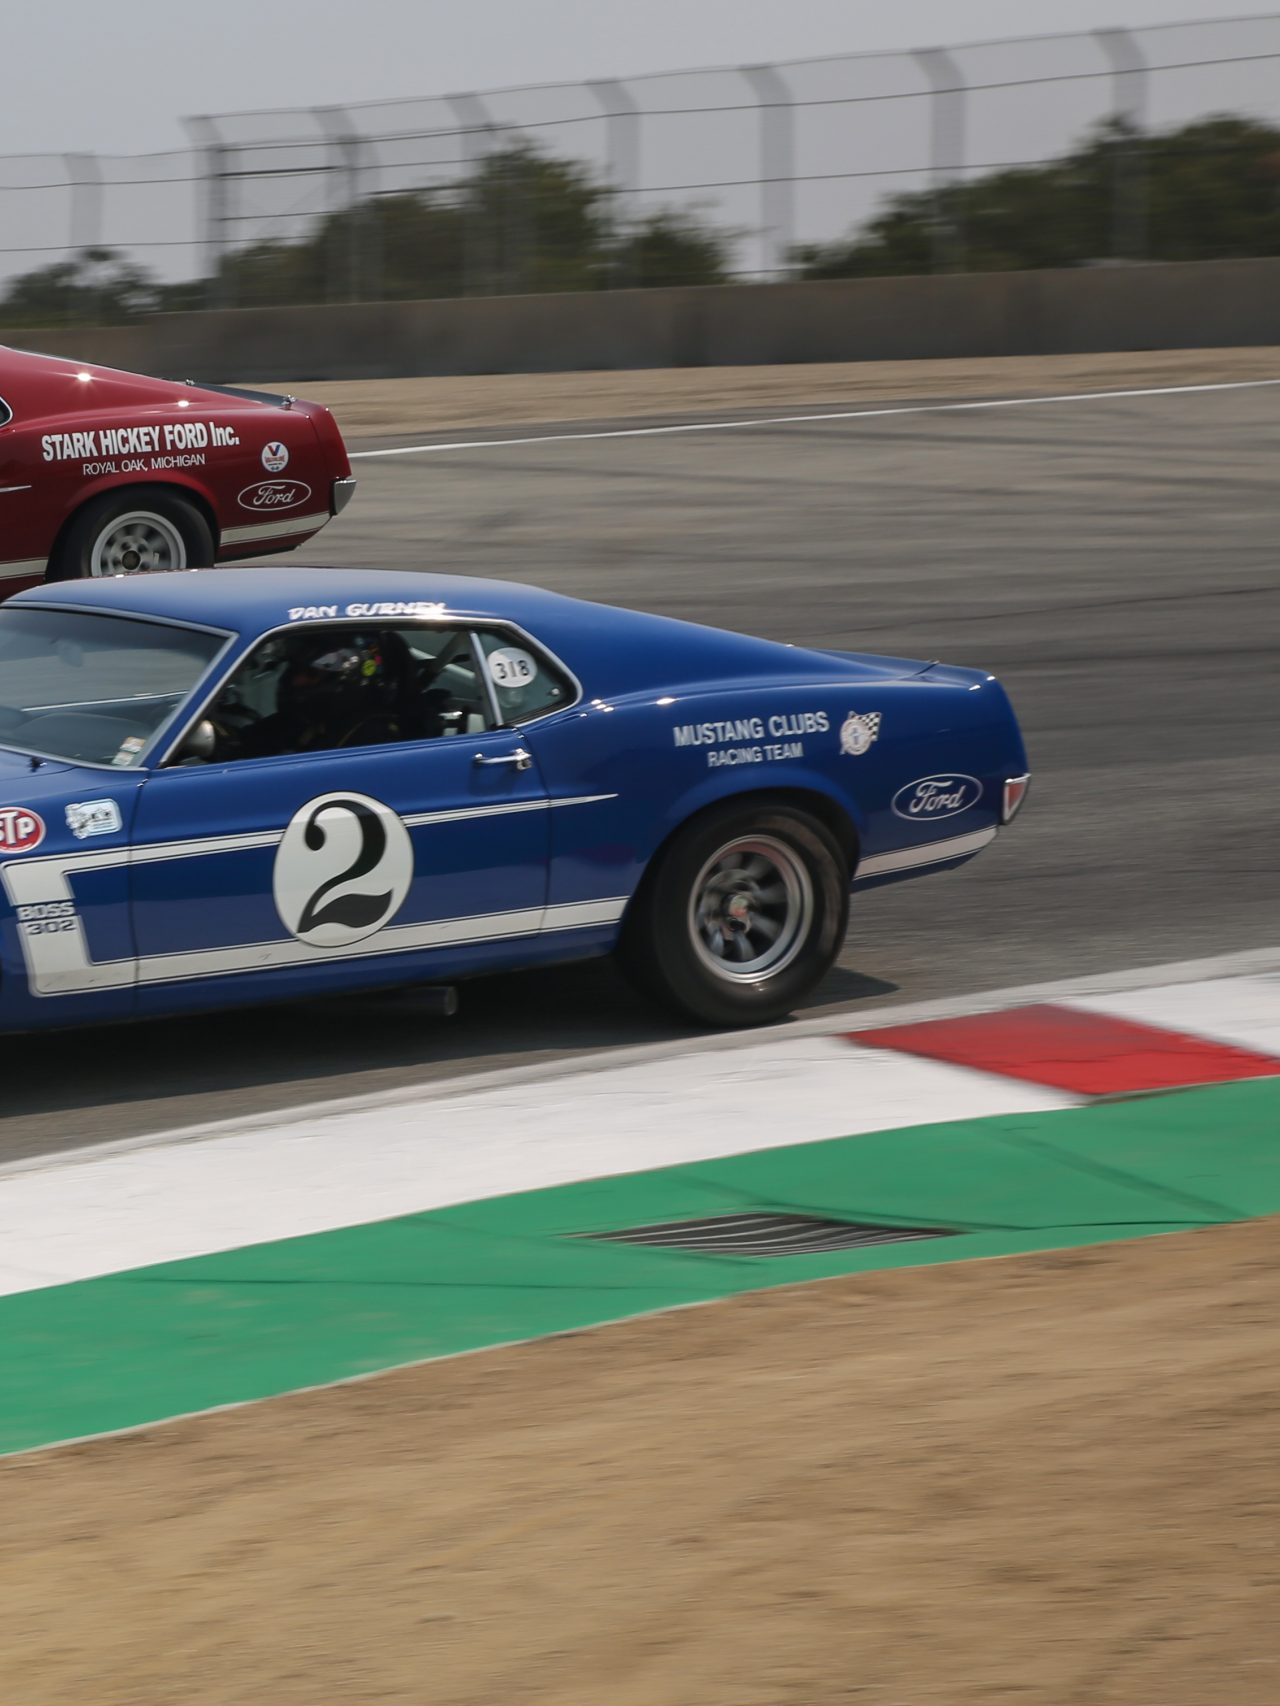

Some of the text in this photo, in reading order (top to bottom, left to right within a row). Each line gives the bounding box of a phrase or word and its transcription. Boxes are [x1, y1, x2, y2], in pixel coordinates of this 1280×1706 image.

[41, 421, 240, 462] STARK HICKEY FORD Inc.
[83, 453, 206, 476] ROYAL OAK, MICHIGAN
[253, 485, 296, 505] Ford
[287, 604, 338, 620] DAN
[494, 659, 530, 680] 318
[673, 717, 765, 747] MUSTANG
[769, 710, 830, 738] CLUBS
[707, 741, 805, 768] RACING TEAM
[909, 780, 967, 813] Ford
[296, 799, 394, 934] 2
[17, 901, 76, 921] BOSS
[26, 918, 78, 936] 302
